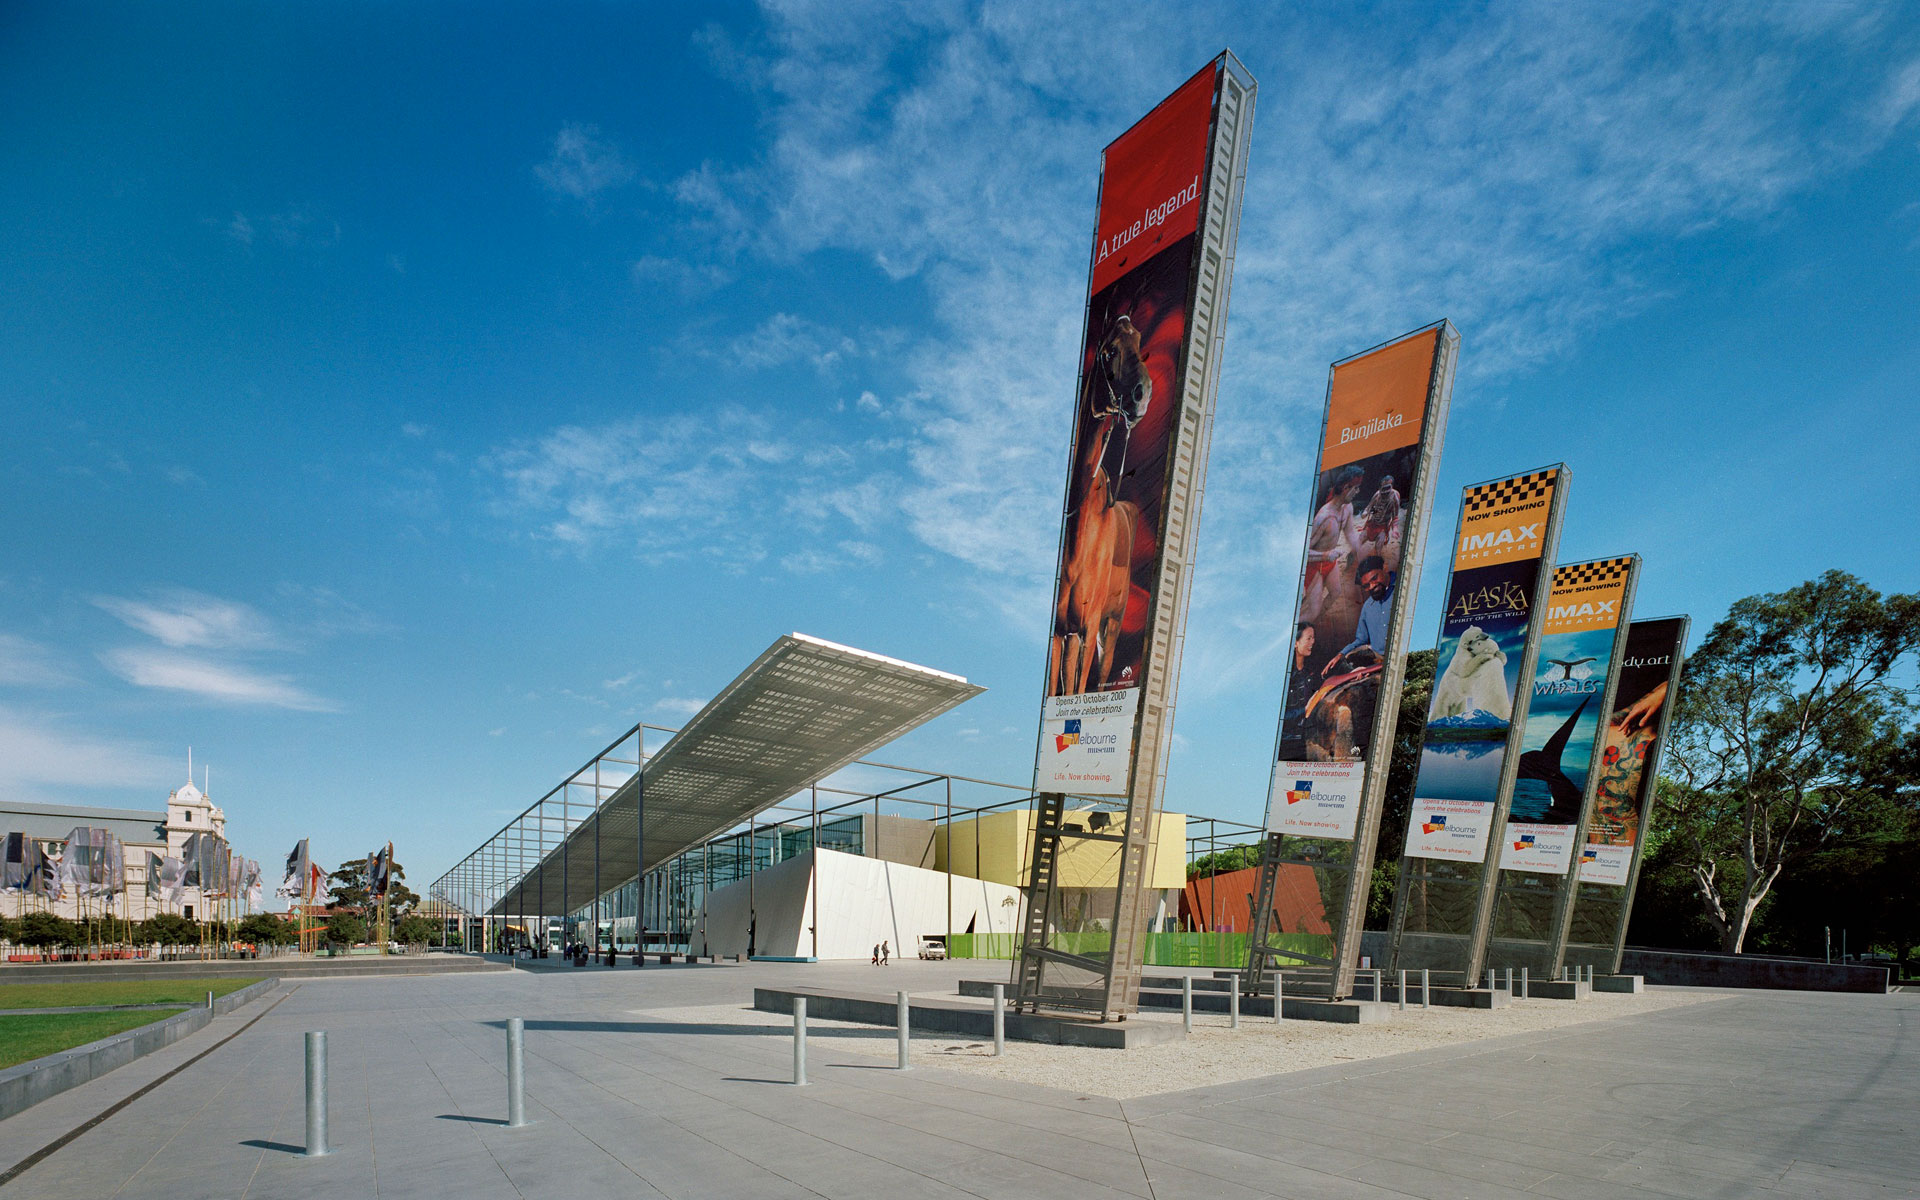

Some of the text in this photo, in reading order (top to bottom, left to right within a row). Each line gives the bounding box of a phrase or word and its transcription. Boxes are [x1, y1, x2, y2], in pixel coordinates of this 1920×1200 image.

[1098, 175, 1199, 264] A true legend
[1340, 413, 1403, 444] Bunjilaka
[1466, 500, 1545, 522] NOW SHOWING
[1461, 522, 1539, 552] IMAX
[1460, 541, 1537, 560] THEATRE
[1552, 581, 1621, 596] NOW SHOWING
[1448, 581, 1529, 616] ALASKA
[1547, 599, 1615, 620] IMAX
[1547, 615, 1614, 627] THEATRE
[1621, 654, 1671, 669] dy art
[1534, 680, 1601, 696] WHALES
[1055, 690, 1127, 706] Opens 21 October 2000
[1055, 704, 1123, 717] Join the celebrations
[1070, 732, 1117, 745] Melbourne
[1068, 772, 1082, 780] Now
[1301, 769, 1311, 777] the
[1311, 769, 1351, 777] celebrations
[1301, 791, 1347, 802] Melbourne
